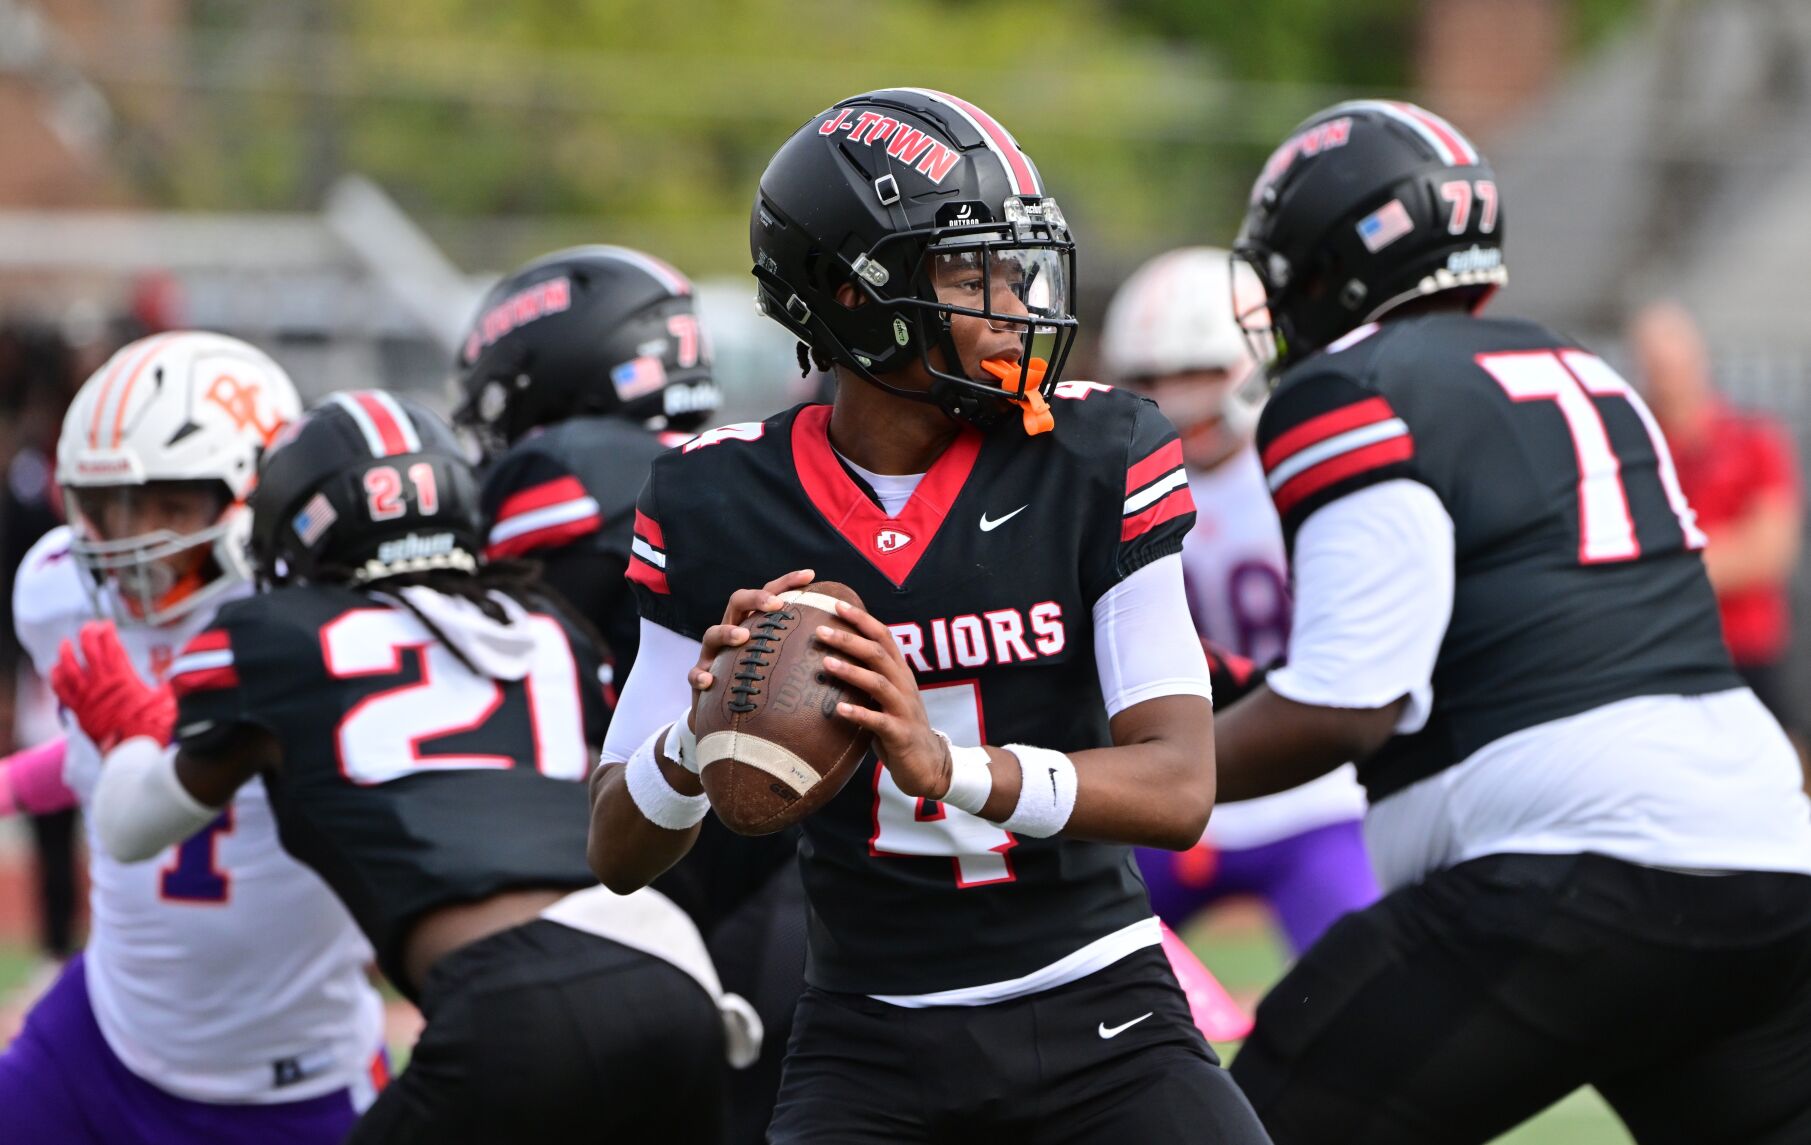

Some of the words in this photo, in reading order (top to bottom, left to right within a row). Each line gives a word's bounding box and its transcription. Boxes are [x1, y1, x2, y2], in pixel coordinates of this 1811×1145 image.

[818, 108, 961, 185] J-TOWN
[1440, 179, 1498, 235] 77
[363, 462, 439, 522] 21
[1472, 346, 1710, 566] 77
[886, 600, 1066, 673] RIORS
[318, 605, 589, 787] 21
[867, 677, 1020, 890] 4
